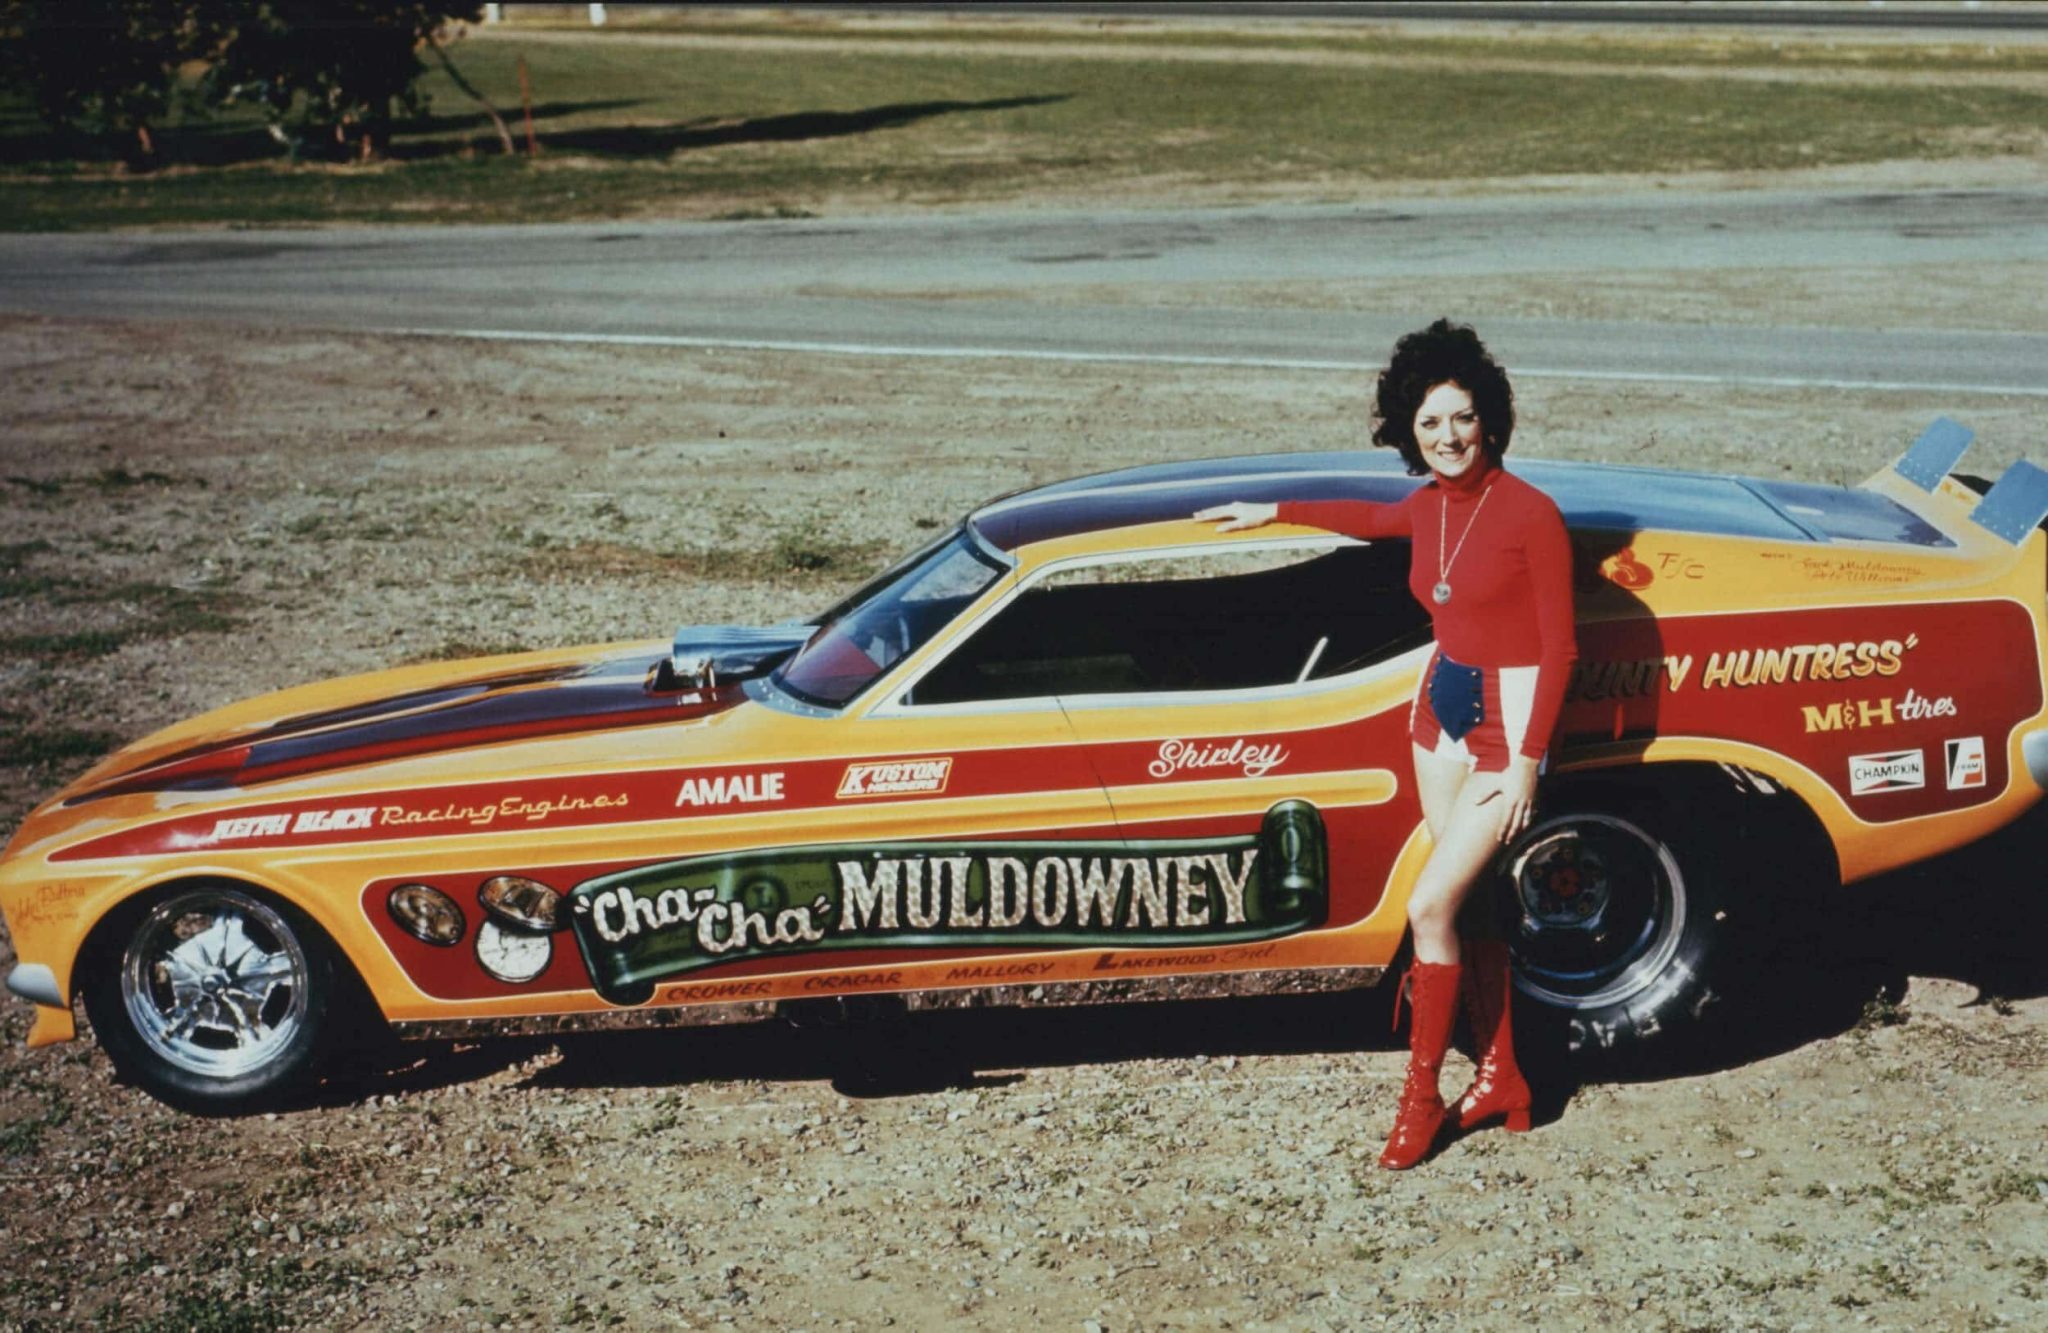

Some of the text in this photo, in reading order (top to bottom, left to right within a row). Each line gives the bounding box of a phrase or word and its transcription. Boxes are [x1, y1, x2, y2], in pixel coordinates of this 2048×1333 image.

[1703, 633, 1919, 689] HUNTRESS"
[1801, 688, 1958, 733] M&H tires
[1148, 738, 1290, 778] Shirley
[675, 772, 785, 807] AMALIE
[292, 807, 377, 833] BLACK
[381, 804, 497, 825] Racing
[500, 793, 629, 821] Engines
[837, 850, 1258, 931] MULDOWNEY
[946, 962, 1055, 980] MALLORY
[1093, 952, 1216, 971] LAKEWOOD
[666, 981, 772, 1000] CROWER
[803, 972, 902, 991] CRAGAR
